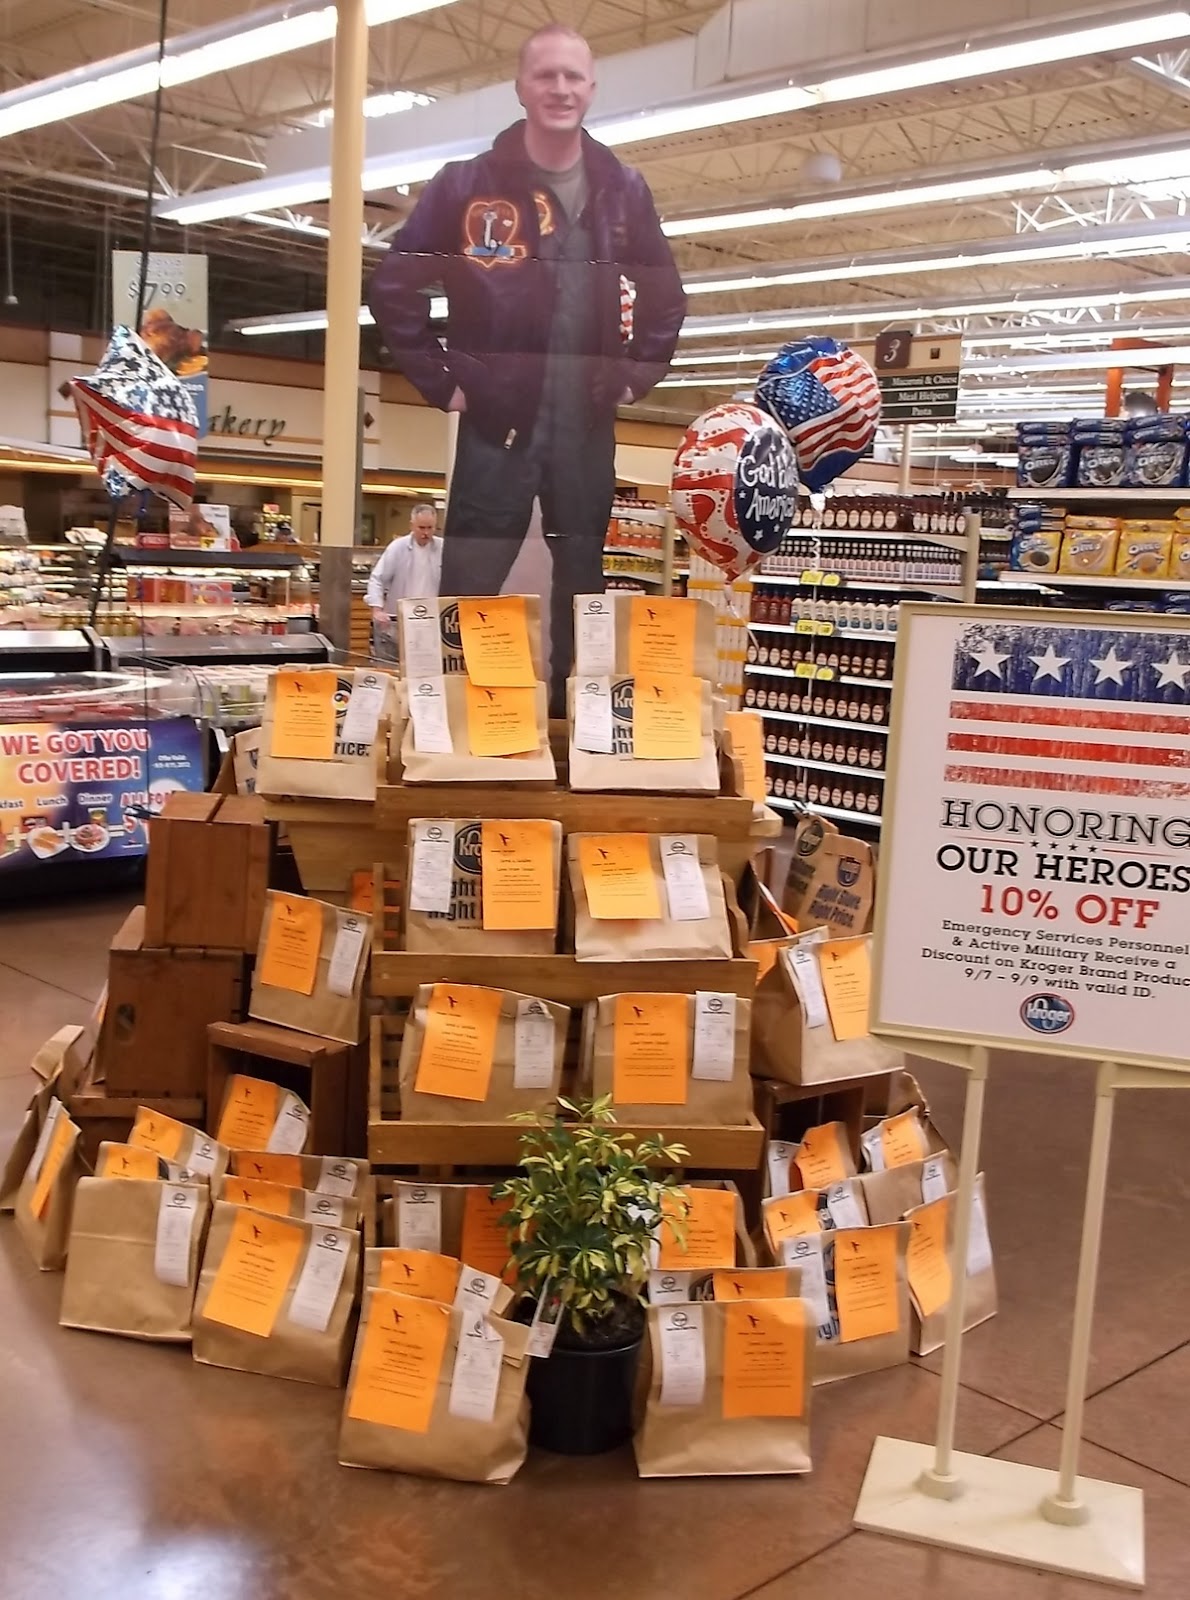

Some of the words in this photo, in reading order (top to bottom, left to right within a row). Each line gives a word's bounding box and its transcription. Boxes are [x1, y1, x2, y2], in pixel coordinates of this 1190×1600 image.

[884, 339, 901, 362] 3
[919, 391, 949, 402] Helpers
[740, 453, 776, 487] God
[1, 735, 39, 756] WE
[46, 731, 96, 755] GOT
[97, 729, 149, 752] YOU
[18, 757, 142, 784] COVERED!
[37, 796, 68, 807] Lunch
[79, 793, 113, 804] Dinner
[941, 798, 1190, 848] HONORING
[937, 844, 1019, 877] OUR
[1034, 853, 1190, 893] HEROES
[980, 884, 1059, 920] 10%
[1075, 894, 1160, 929] OFF
[942, 919, 1031, 941] Emergency
[1036, 929, 1103, 947] Services
[1109, 937, 1190, 955] Personnel
[952, 936, 963, 947] &
[969, 938, 1020, 953] Active
[1025, 944, 1089, 963] Military
[1095, 951, 1160, 969] Receive
[1165, 960, 1177, 970] a
[921, 948, 990, 965] Discount
[995, 958, 1015, 968] on
[1020, 958, 1074, 976] Kroger
[1079, 965, 1128, 981] Brand
[964, 968, 993, 981] 9/7
[1011, 973, 1039, 987] 9/9
[1044, 977, 1080, 990] with
[1085, 981, 1127, 996] valid
[1132, 986, 1156, 999] ID.
